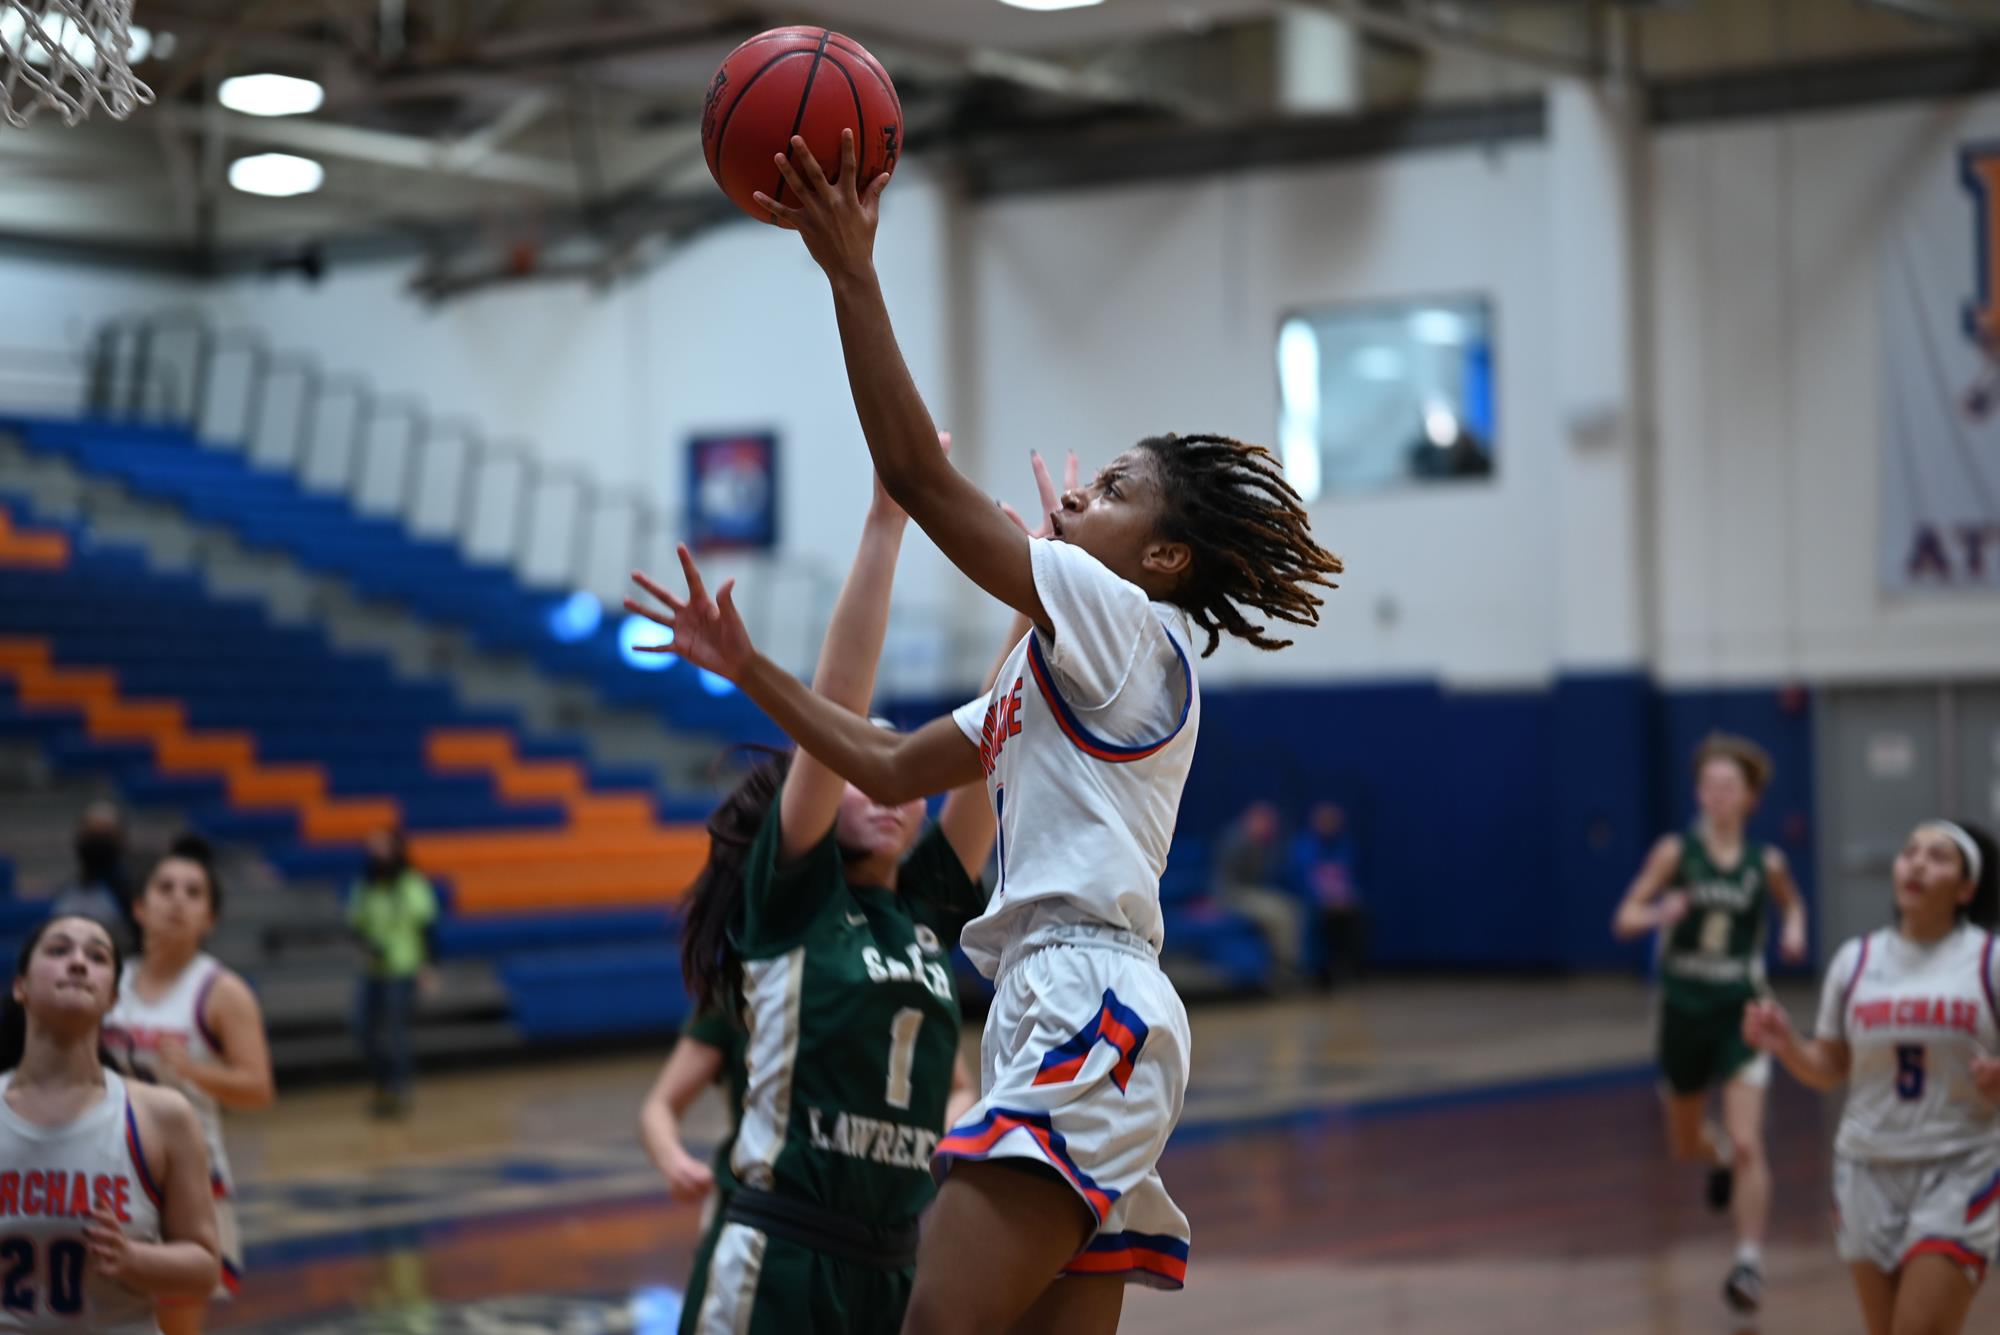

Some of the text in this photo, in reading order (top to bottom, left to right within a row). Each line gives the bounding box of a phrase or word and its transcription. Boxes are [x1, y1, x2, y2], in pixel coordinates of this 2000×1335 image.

[885, 1006, 926, 1111] 1
[1895, 1043, 1927, 1102] 5
[0, 1235, 87, 1316] 20
